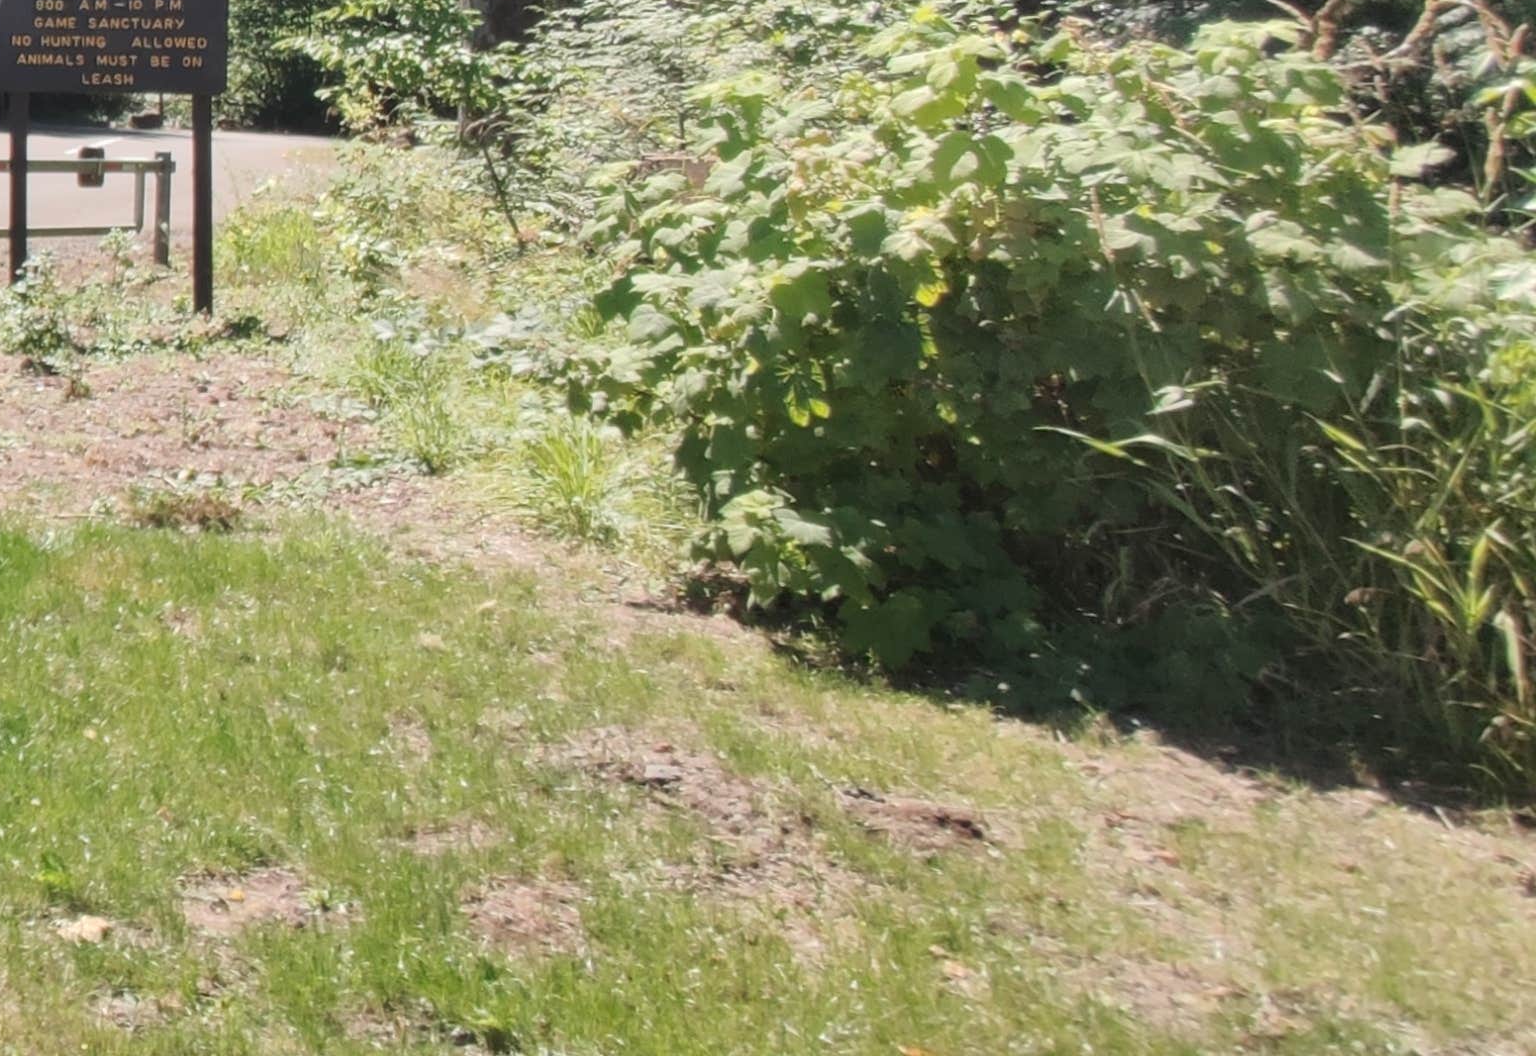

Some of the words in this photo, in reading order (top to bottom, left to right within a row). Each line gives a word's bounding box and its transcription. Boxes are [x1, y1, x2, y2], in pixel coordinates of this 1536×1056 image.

[34, 17, 77, 29] GAME
[88, 17, 185, 30] SANCTUARY
[11, 35, 32, 47] NO
[41, 35, 106, 48] HUNTING
[131, 36, 208, 49] ALLOWED
[16, 53, 85, 66] ANIMALS
[96, 55, 138, 67] MUST
[150, 55, 170, 68] BE
[182, 56, 203, 67] ON
[81, 73, 135, 85] LEASH
